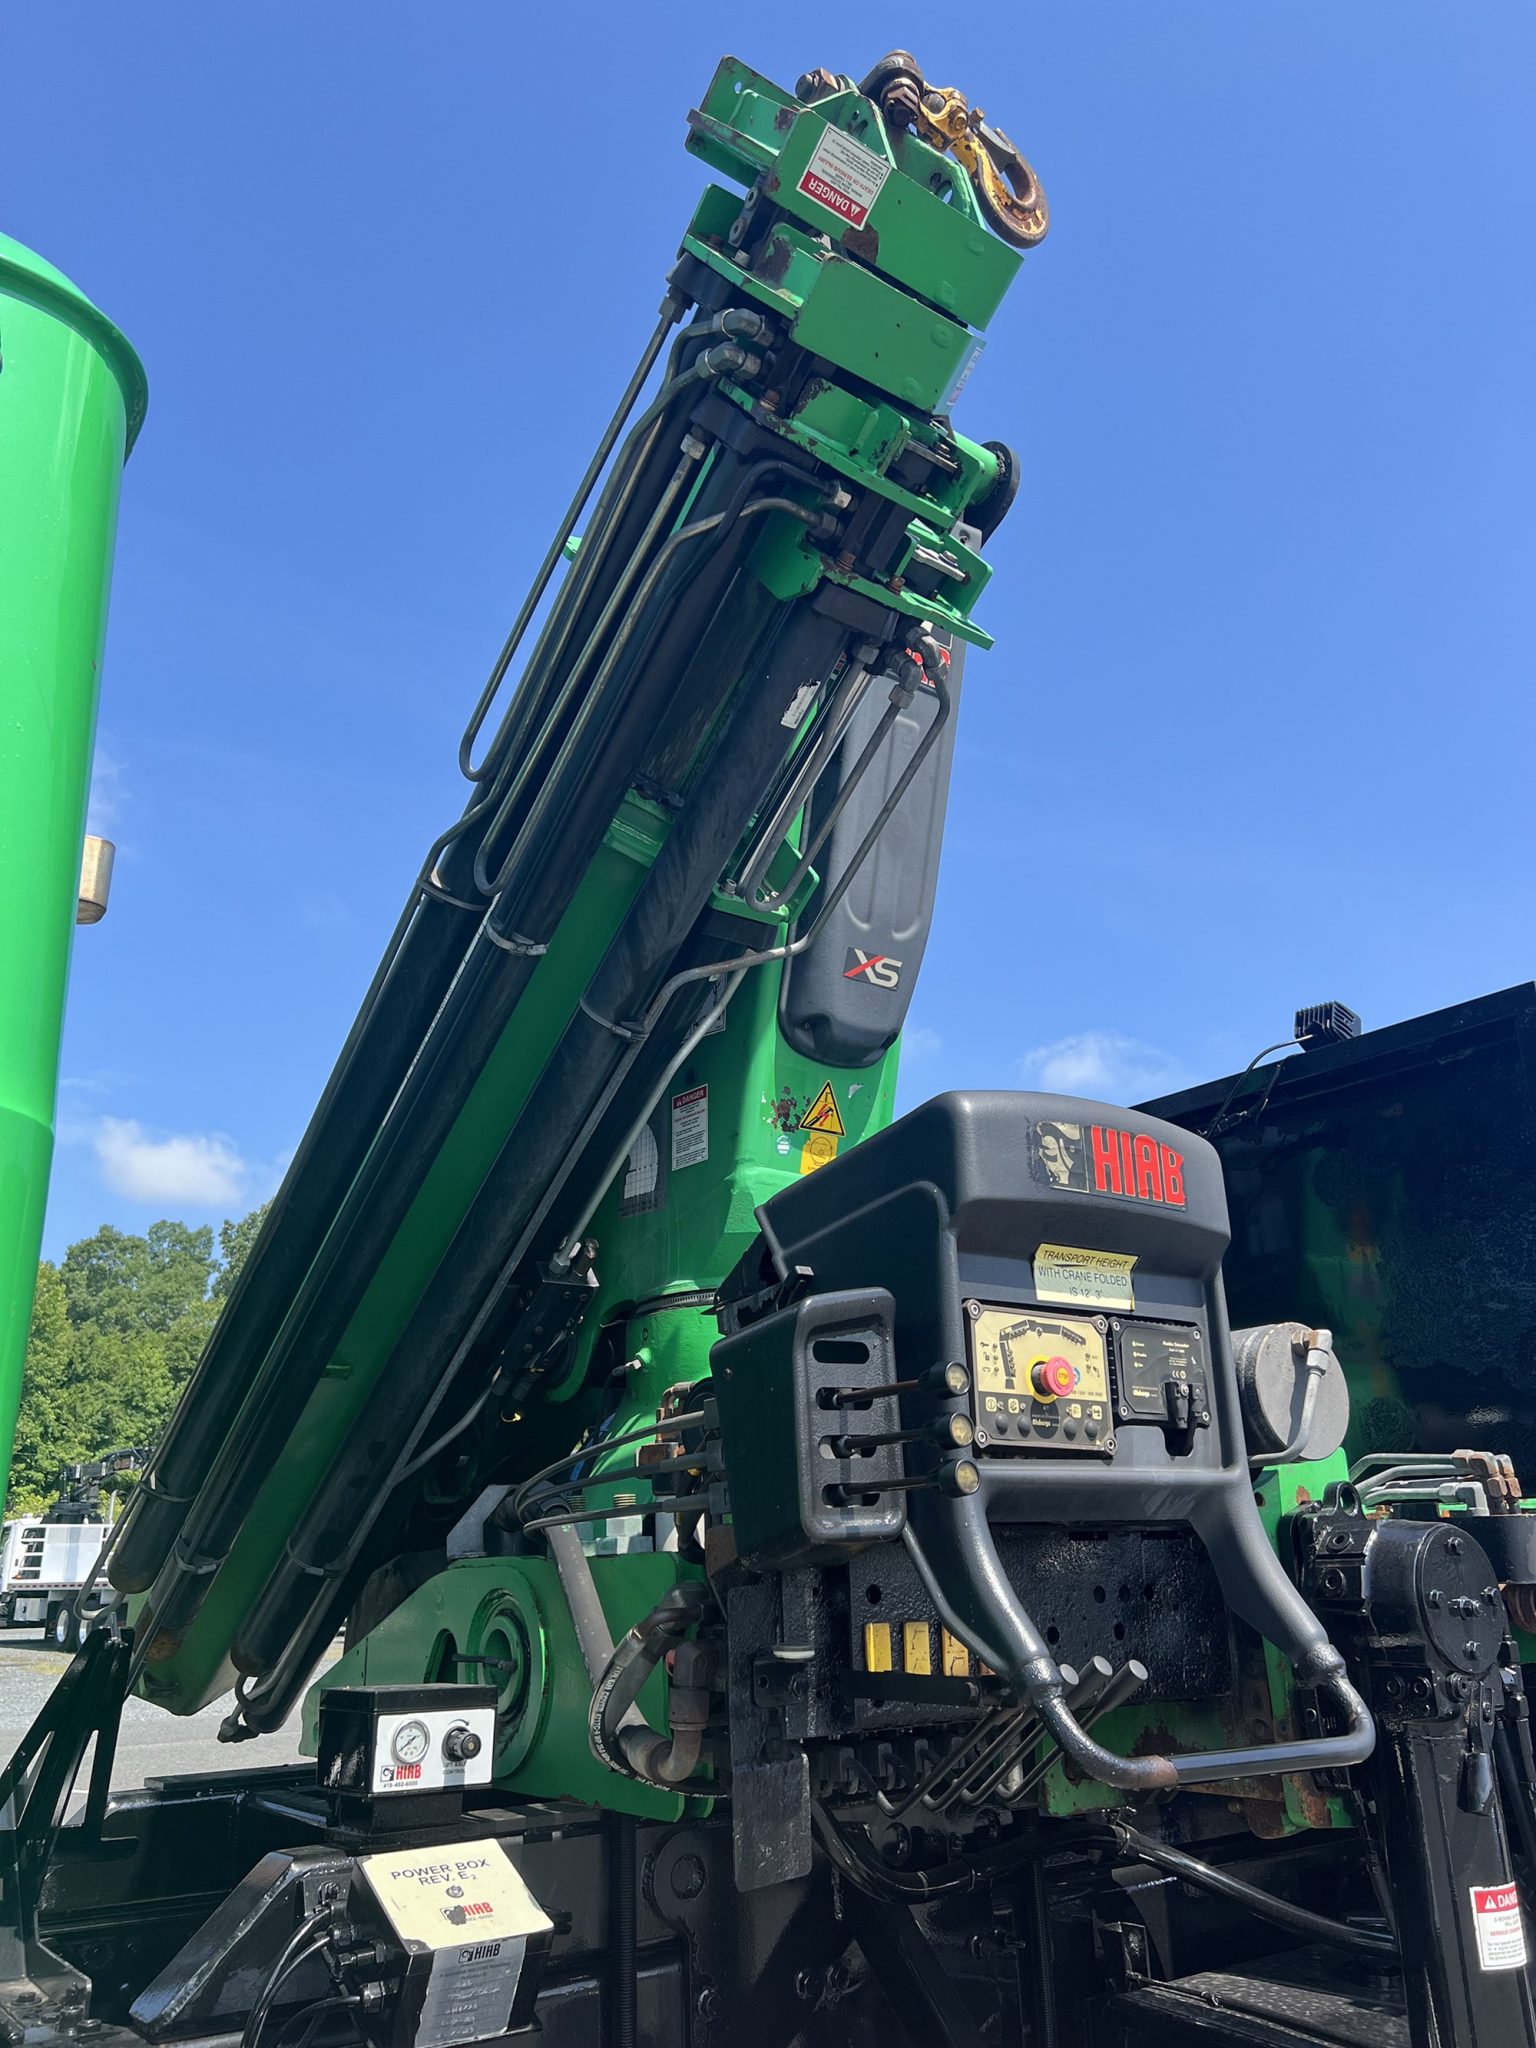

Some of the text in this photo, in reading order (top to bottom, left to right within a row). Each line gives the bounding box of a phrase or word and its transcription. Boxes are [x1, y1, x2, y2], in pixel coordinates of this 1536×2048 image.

[817, 155, 833, 168] INJURY
[833, 165, 852, 180] SERIOUS
[807, 177, 850, 211] DANGER
[859, 182, 874, 195] DEATH
[843, 948, 902, 988] XS
[682, 1089, 703, 1104] DANGER
[1091, 1124, 1186, 1205] HIAB
[1044, 1250, 1128, 1269] TRANSPORT HEIGHT
[1038, 1266, 1128, 1286] WITH CRANE FOLDED
[1070, 1287, 1078, 1296] IS
[396, 1764, 421, 1780] HIAB
[391, 1859, 490, 1880] POWER BOX
[419, 1874, 455, 1886] REV.
[474, 1944, 500, 1960] HIAB
